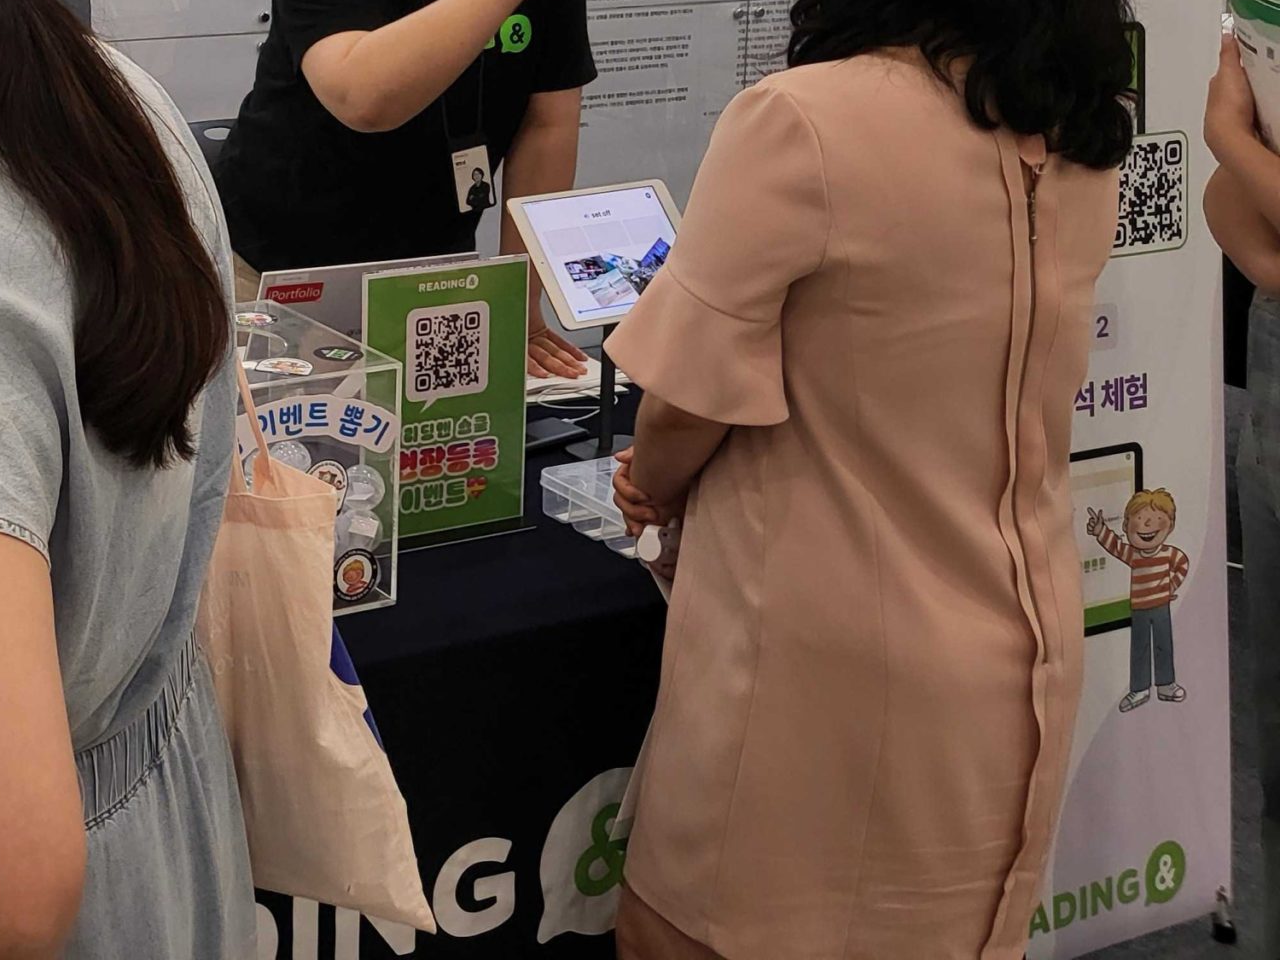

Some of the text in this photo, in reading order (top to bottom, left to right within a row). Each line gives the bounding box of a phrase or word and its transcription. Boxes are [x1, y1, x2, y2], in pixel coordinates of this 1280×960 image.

[1096, 315, 1109, 338] 2
[1100, 372, 1148, 412] 체험
[257, 402, 390, 446] 이벤트 뽑기
[455, 412, 491, 439] 스쿨
[399, 436, 499, 483] 현장등록
[400, 477, 469, 514] 이벤트
